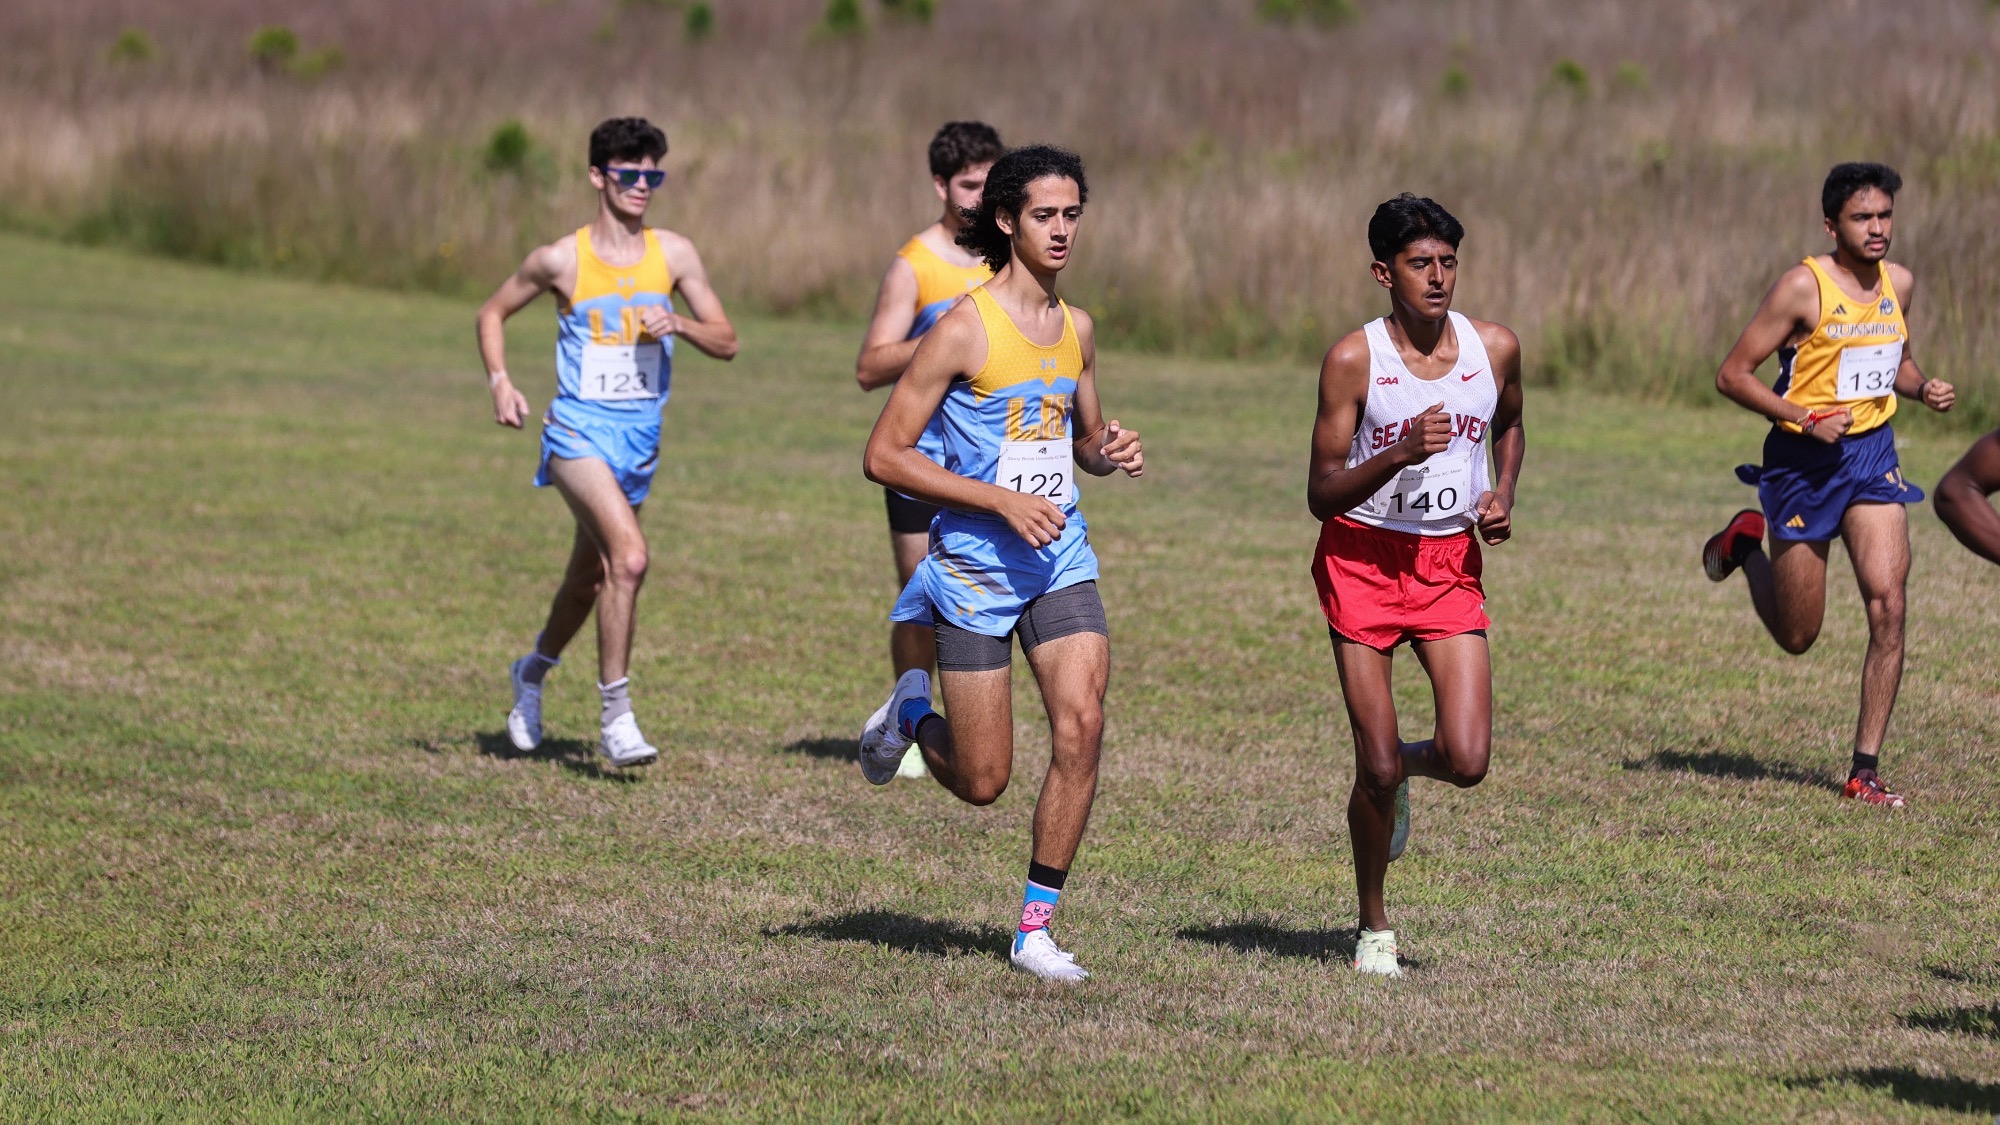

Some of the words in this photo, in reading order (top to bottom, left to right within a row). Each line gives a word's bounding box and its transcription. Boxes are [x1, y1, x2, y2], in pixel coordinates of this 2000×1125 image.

[1827, 321, 1901, 340] QUINNIPIAC
[594, 371, 647, 393] 123
[1376, 376, 1399, 386] CAA
[1849, 367, 1896, 392] 132
[1371, 414, 1489, 450] SEAVES
[1010, 472, 1063, 498] 122
[1416, 473, 1441, 481] University
[1389, 487, 1457, 514] 140
